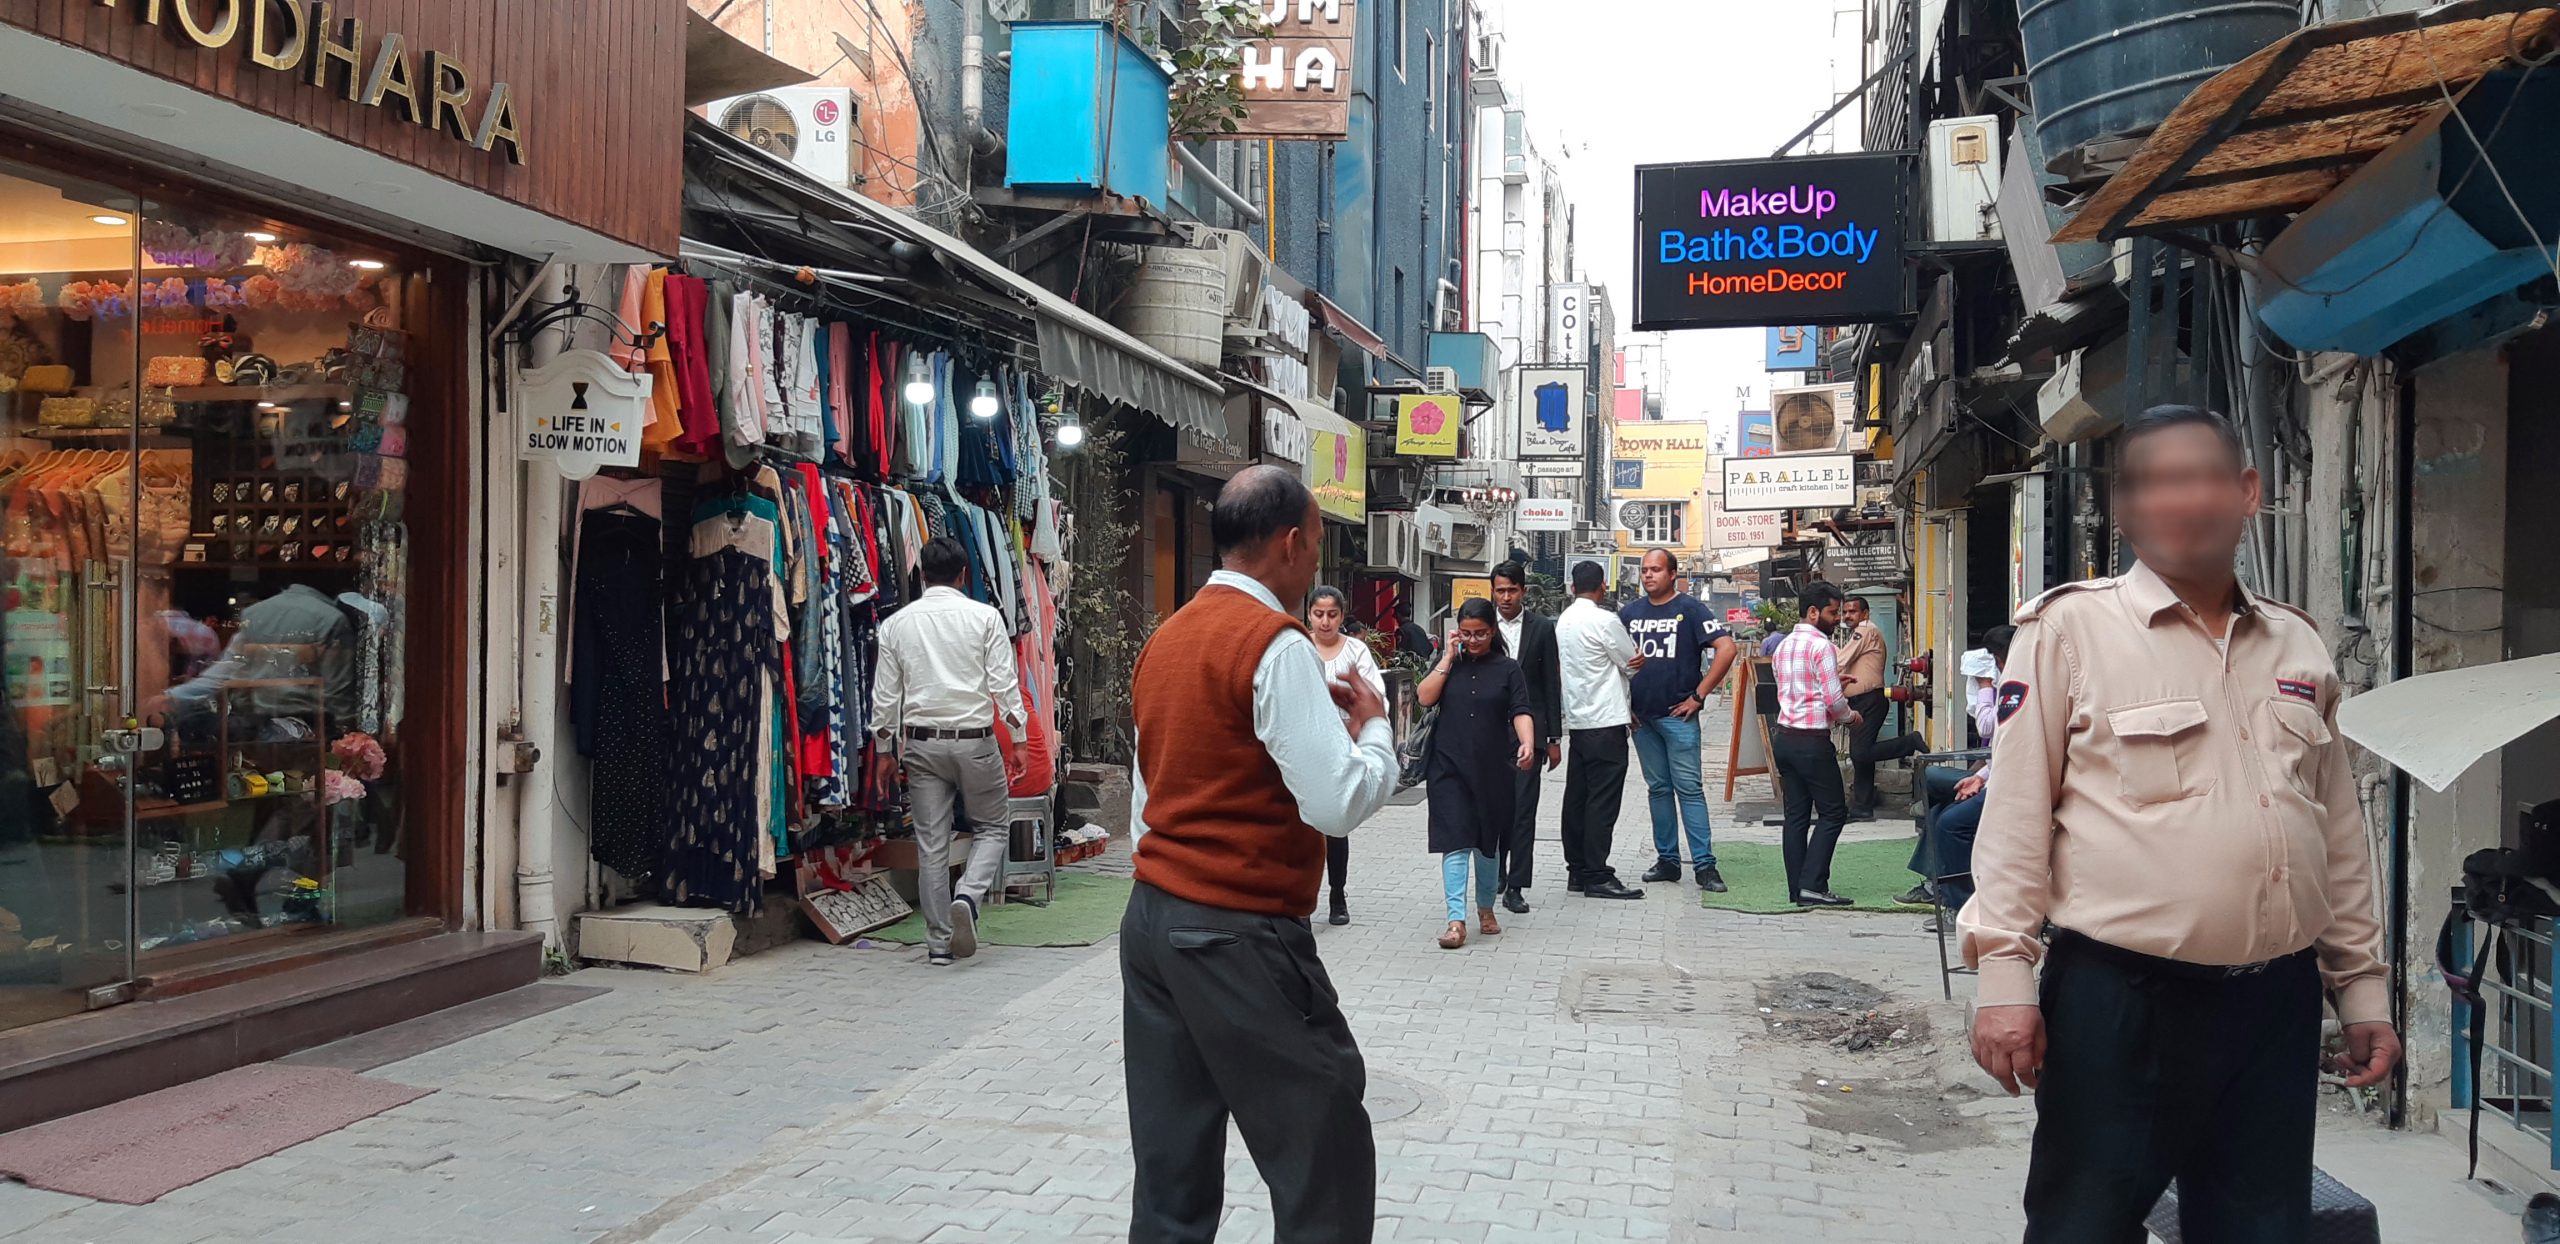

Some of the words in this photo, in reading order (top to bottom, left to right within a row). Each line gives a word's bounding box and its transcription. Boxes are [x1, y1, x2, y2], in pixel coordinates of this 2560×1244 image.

[815, 130, 836, 143] LG
[1700, 184, 1836, 220] MakeUp
[1659, 221, 1878, 265] Bath&Body
[1687, 268, 1848, 296] HomeDecor
[552, 416, 585, 432] LIFE
[590, 418, 606, 434] IN
[528, 433, 569, 450] SLOW
[573, 435, 628, 454] MOTION
[1525, 436, 1547, 446] Blue
[1549, 436, 1569, 446] Door
[1619, 438, 1663, 451] TOWN
[1666, 438, 1704, 450] HALL
[1537, 466, 1565, 474] passage
[1729, 468, 1849, 485] PARALLEL
[1778, 484, 1798, 492] craft
[1522, 508, 1553, 517] choko
[1716, 516, 1741, 527] BOOK
[1747, 514, 1775, 526] STORE
[1727, 531, 1748, 542] ESTD.
[1750, 531, 1765, 541] 1951
[1826, 547, 1858, 557] GULSHAN
[1860, 546, 1892, 556] ELECTRIC
[1629, 618, 1678, 633] SUPER
